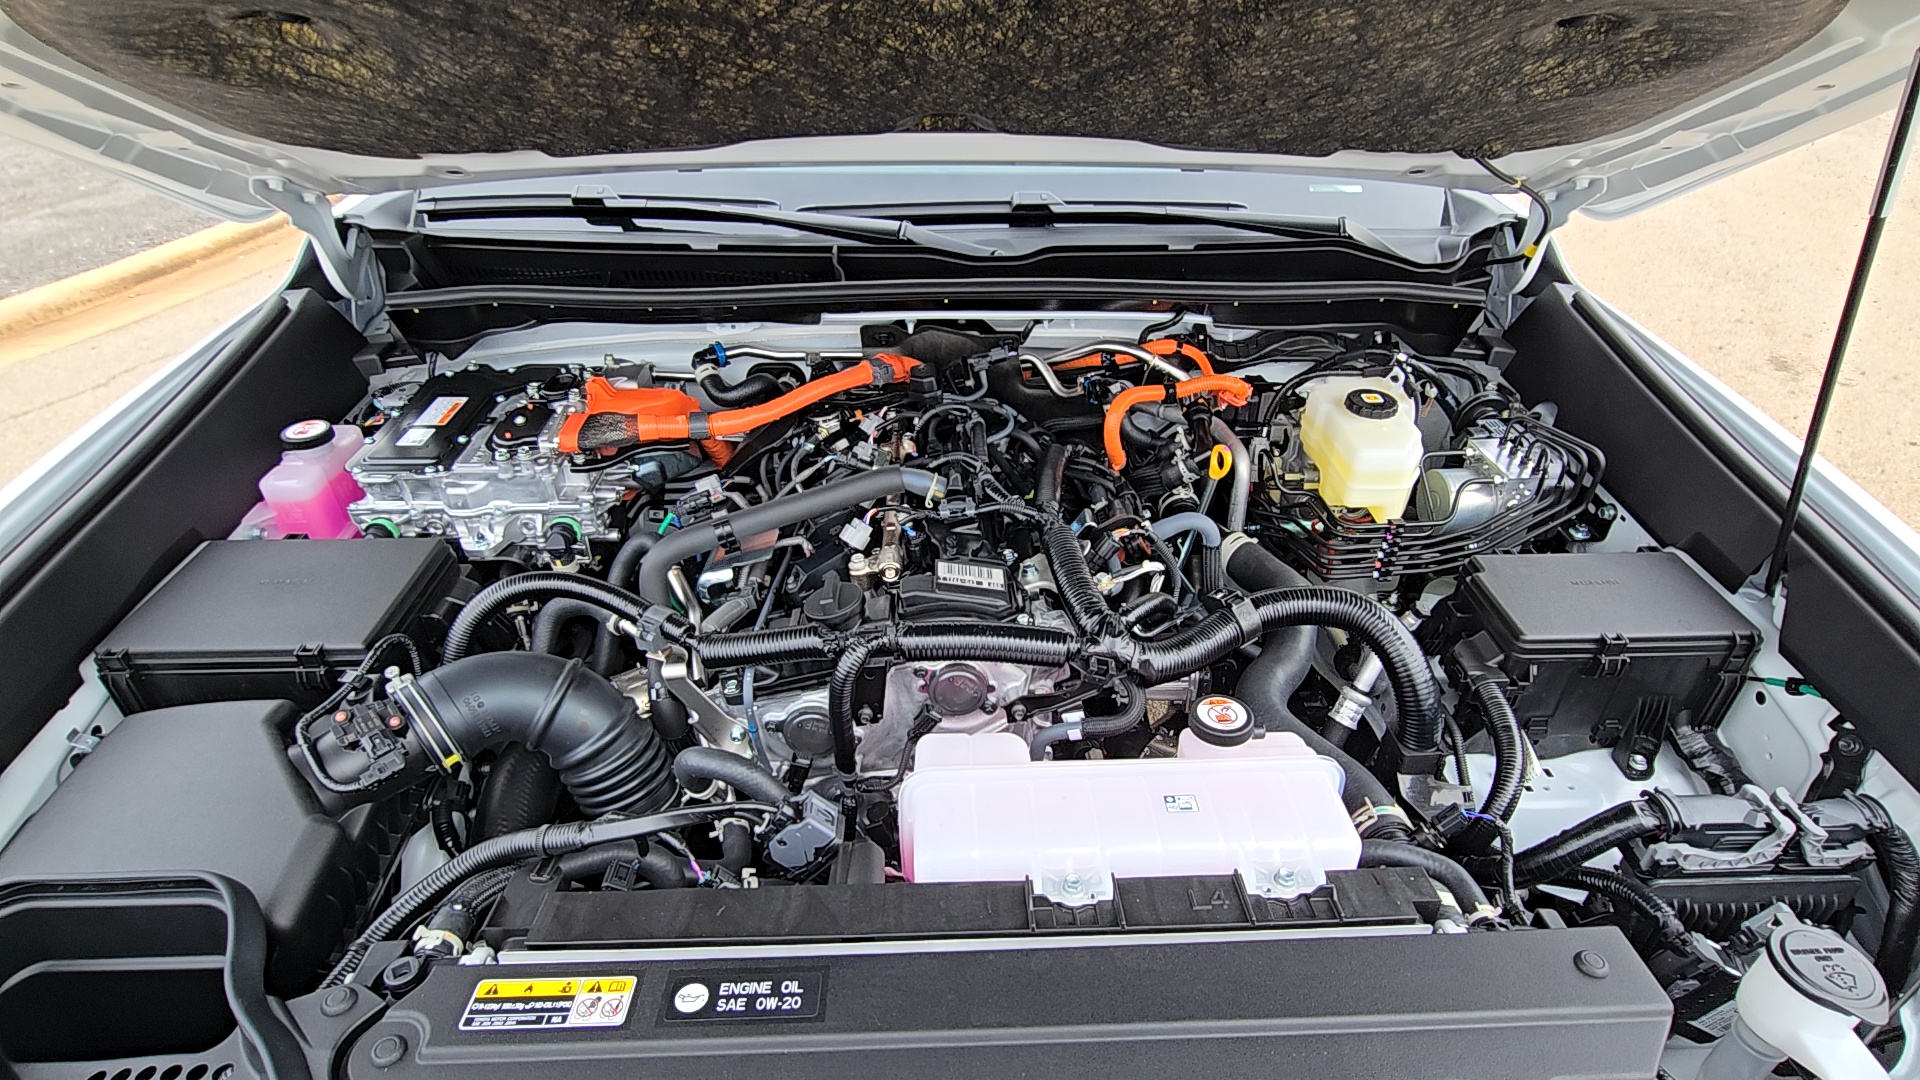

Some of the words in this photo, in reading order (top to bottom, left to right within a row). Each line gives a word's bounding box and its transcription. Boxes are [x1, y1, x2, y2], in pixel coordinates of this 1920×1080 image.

[1187, 888, 1230, 911] L4
[719, 981, 773, 995] ENGINE
[781, 981, 804, 994] OIL
[716, 998, 747, 1011] SAE
[755, 996, 802, 1011] 0W-20
